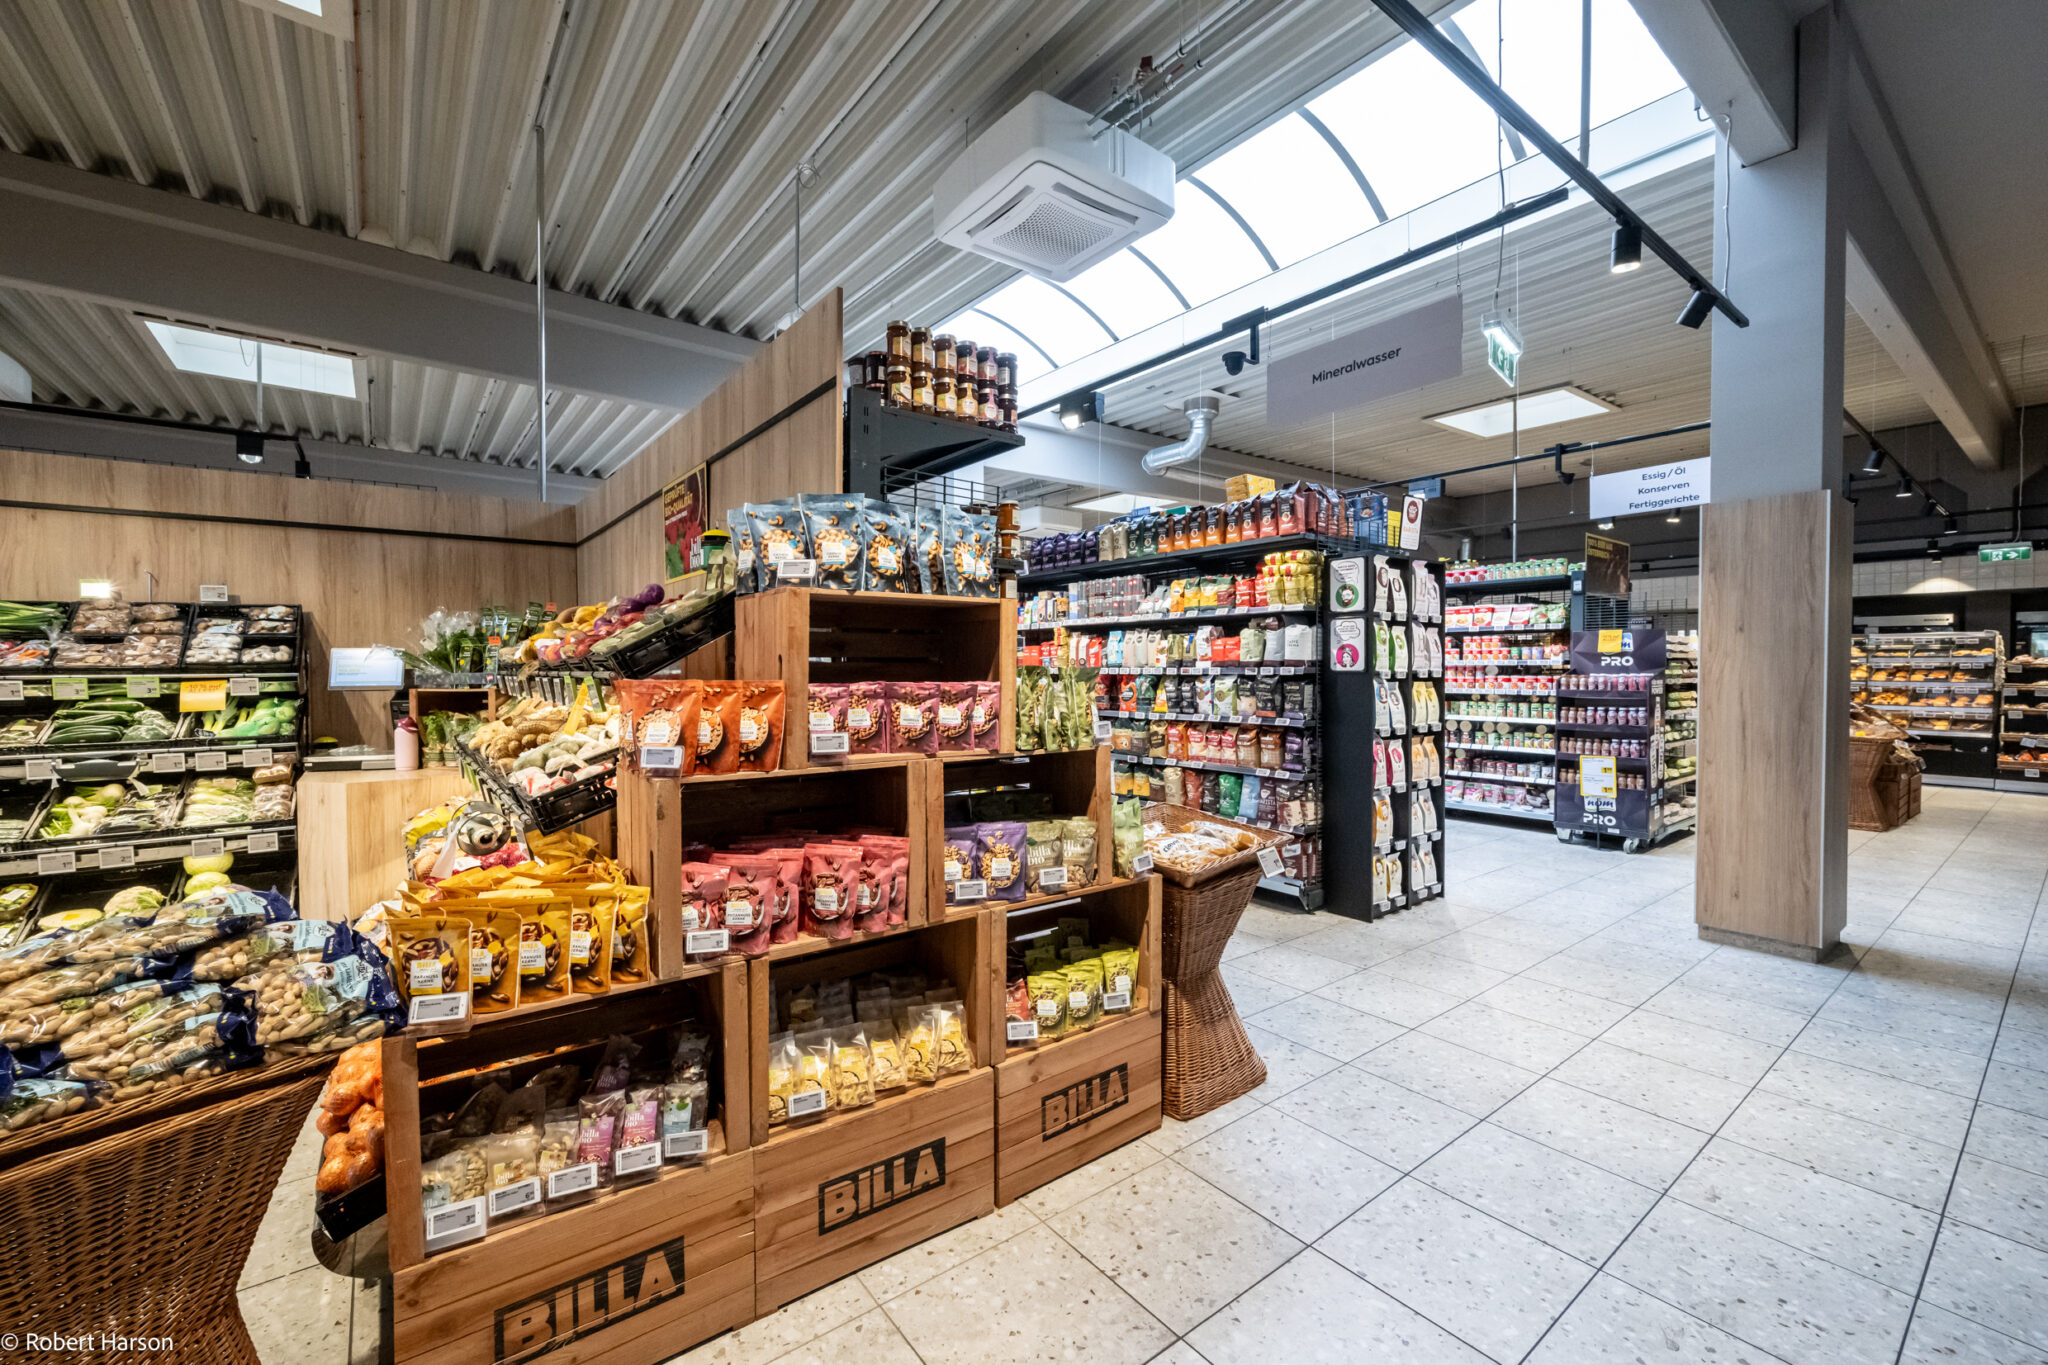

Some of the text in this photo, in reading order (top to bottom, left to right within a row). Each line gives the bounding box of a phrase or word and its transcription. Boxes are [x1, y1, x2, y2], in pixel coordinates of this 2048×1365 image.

[1312, 347, 1402, 385] Mineralwasser
[1642, 470, 1666, 481] Essig
[1674, 466, 1686, 475] Öl
[1638, 481, 1690, 495] Konserven
[1629, 494, 1700, 510] Fertiggerichte
[1601, 656, 1633, 666] PRO
[1583, 812, 1617, 826] PRO
[1029, 845, 1051, 856] billa
[1064, 839, 1081, 852] illa
[1027, 856, 1045, 866] bio
[1045, 1071, 1125, 1136] BILLA
[626, 1111, 645, 1122] billa
[580, 1128, 600, 1139] billa
[824, 1147, 940, 1229] BILLA
[502, 1250, 678, 1360] BILLA
